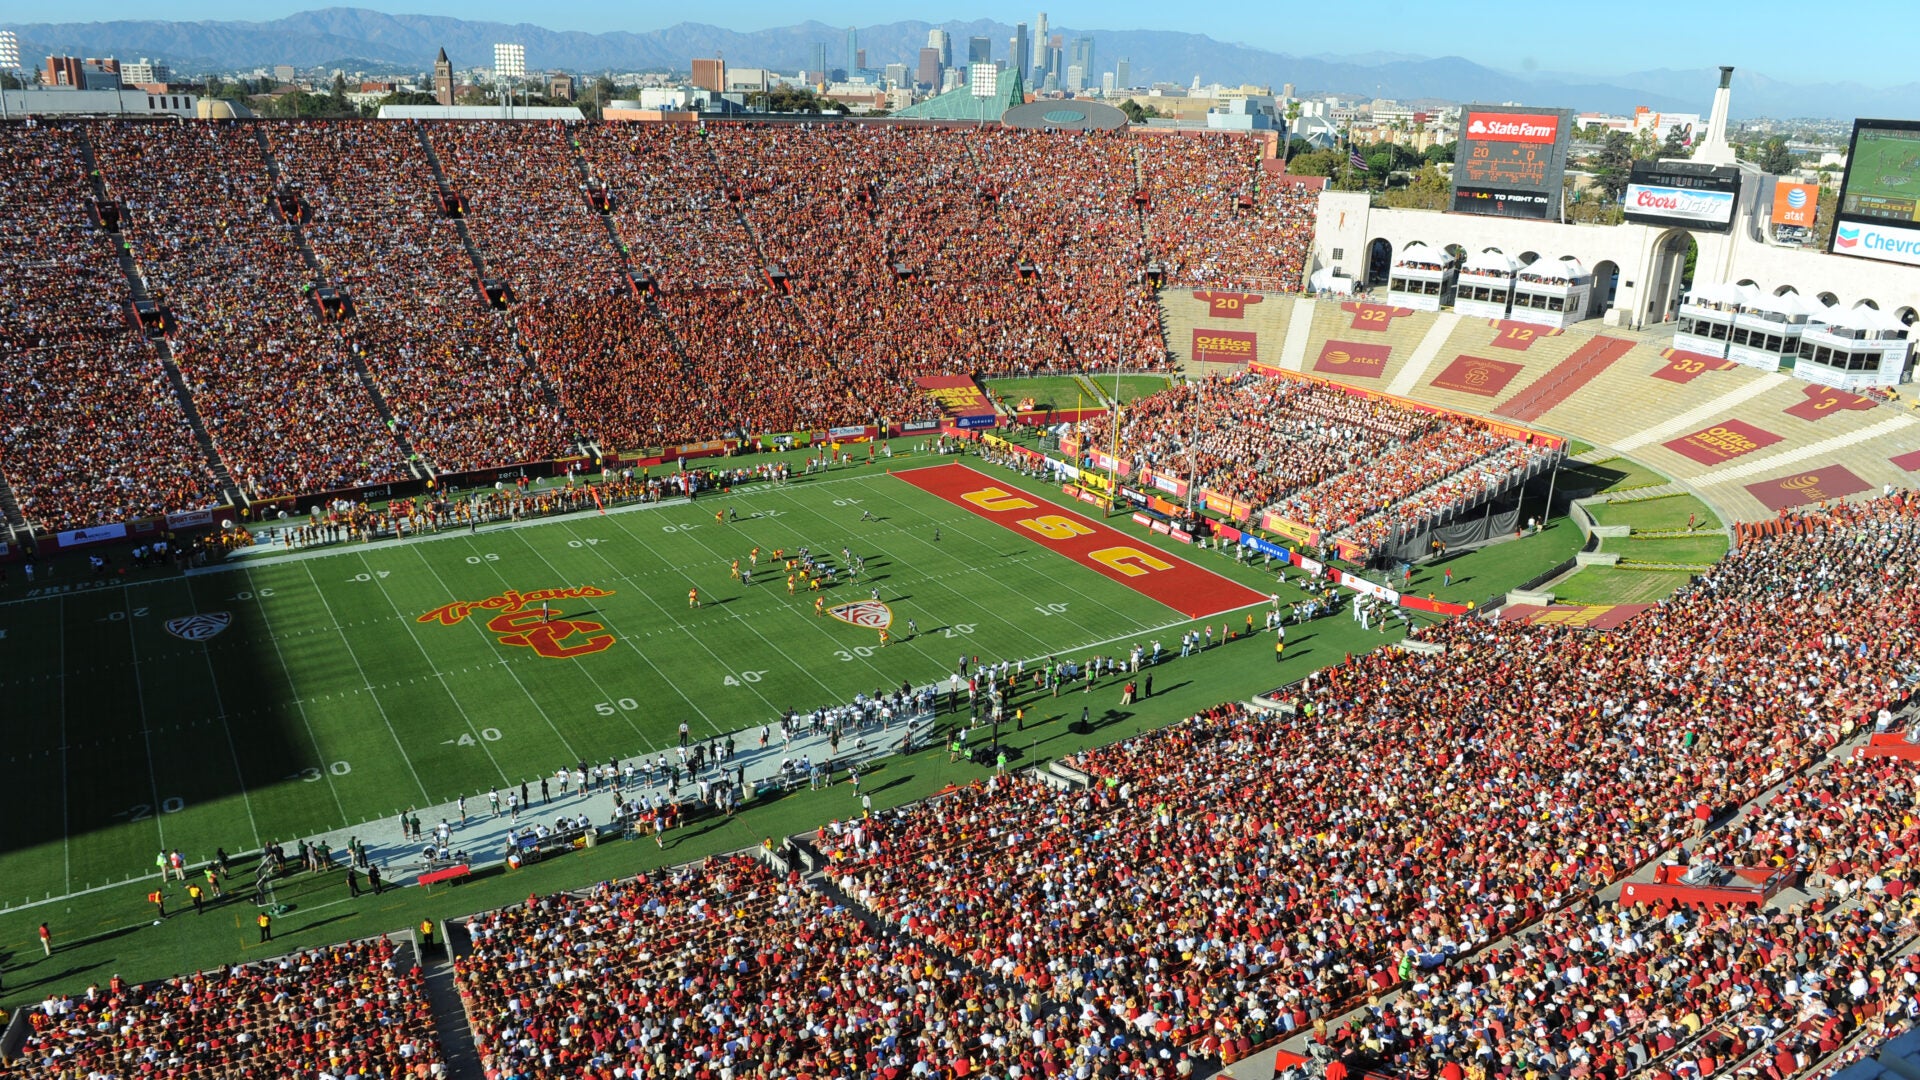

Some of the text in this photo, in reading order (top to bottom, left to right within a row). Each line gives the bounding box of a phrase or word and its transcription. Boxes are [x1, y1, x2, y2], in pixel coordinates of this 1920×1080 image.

[1473, 147, 1489, 157] 20
[1471, 191, 1492, 199] PLAY
[1507, 194, 1532, 203] FIGHT
[1533, 196, 1548, 204] ON
[1637, 190, 1723, 214] Coors LIGHT
[1784, 211, 1804, 222] at&t
[1864, 232, 1920, 256] Chevro
[1216, 299, 1239, 309] 20
[1361, 309, 1387, 322] 32
[1507, 328, 1534, 341] 12
[1197, 337, 1251, 347] Office
[1198, 344, 1251, 352] DEPOT
[1352, 356, 1379, 366] at&t
[1673, 359, 1705, 373] 33
[1814, 398, 1837, 410] 3
[1694, 432, 1745, 454] DEPOT
[1708, 427, 1757, 450] Office
[498, 471, 518, 479] zero
[363, 489, 385, 498] zero
[662, 523, 694, 533] 30
[961, 487, 1176, 579] USC
[567, 538, 600, 548] 40
[1259, 544, 1284, 558] FARMERS
[466, 553, 500, 564] 50
[355, 570, 391, 582] 40
[416, 586, 616, 625] Trojans
[1035, 602, 1062, 616] 10
[943, 624, 972, 639] 20
[833, 646, 870, 662] 30
[722, 669, 762, 687] 40
[594, 697, 639, 716] 50
[457, 727, 503, 747] 40
[302, 760, 352, 782] 30
[127, 796, 184, 822] 20
